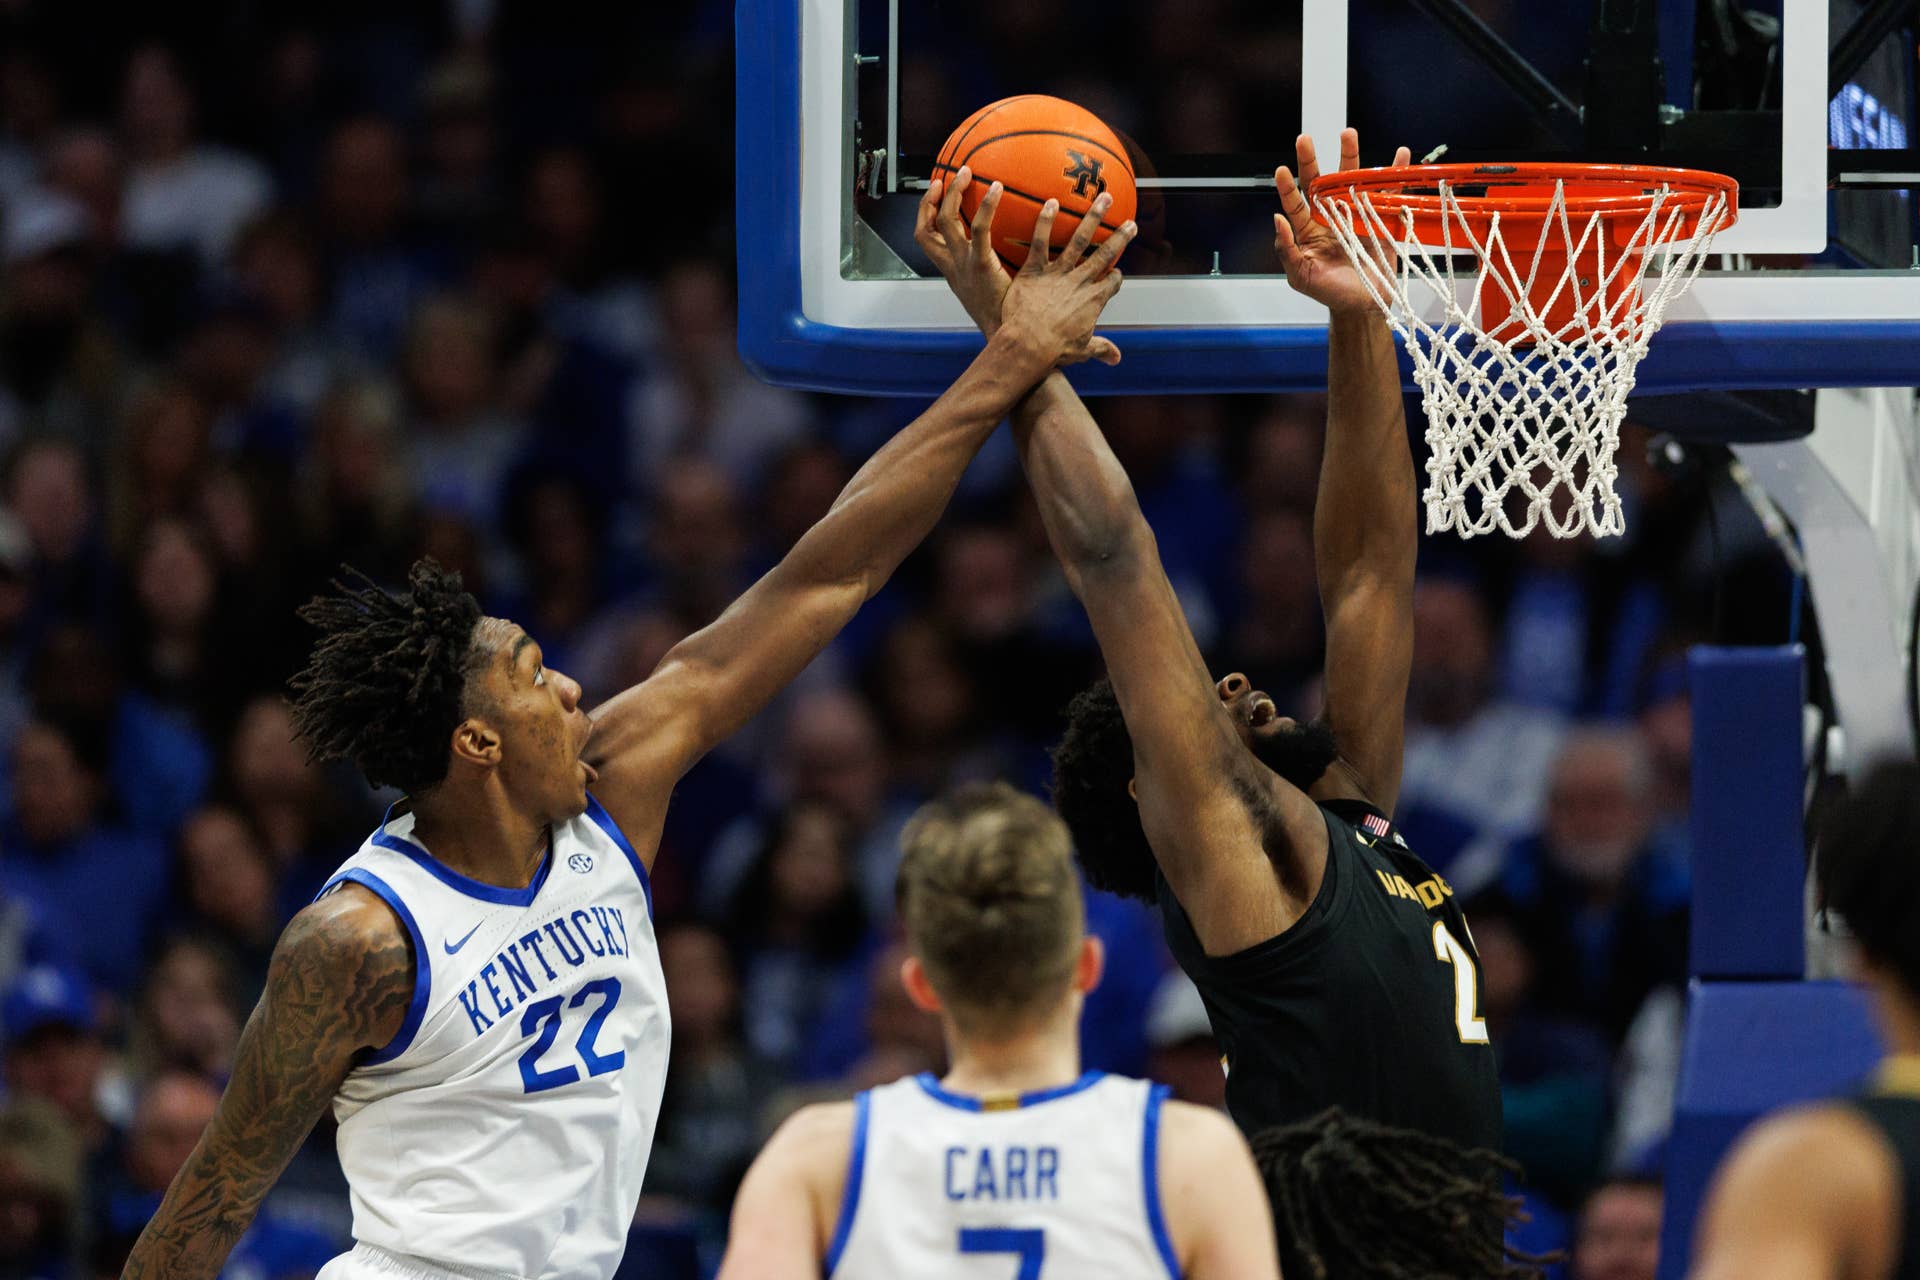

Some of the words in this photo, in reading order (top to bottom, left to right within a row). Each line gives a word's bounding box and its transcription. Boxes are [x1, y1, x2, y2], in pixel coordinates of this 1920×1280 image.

[458, 906, 629, 1036] KENTUCKY
[518, 976, 626, 1094] 22
[945, 1147, 1058, 1200] CARR
